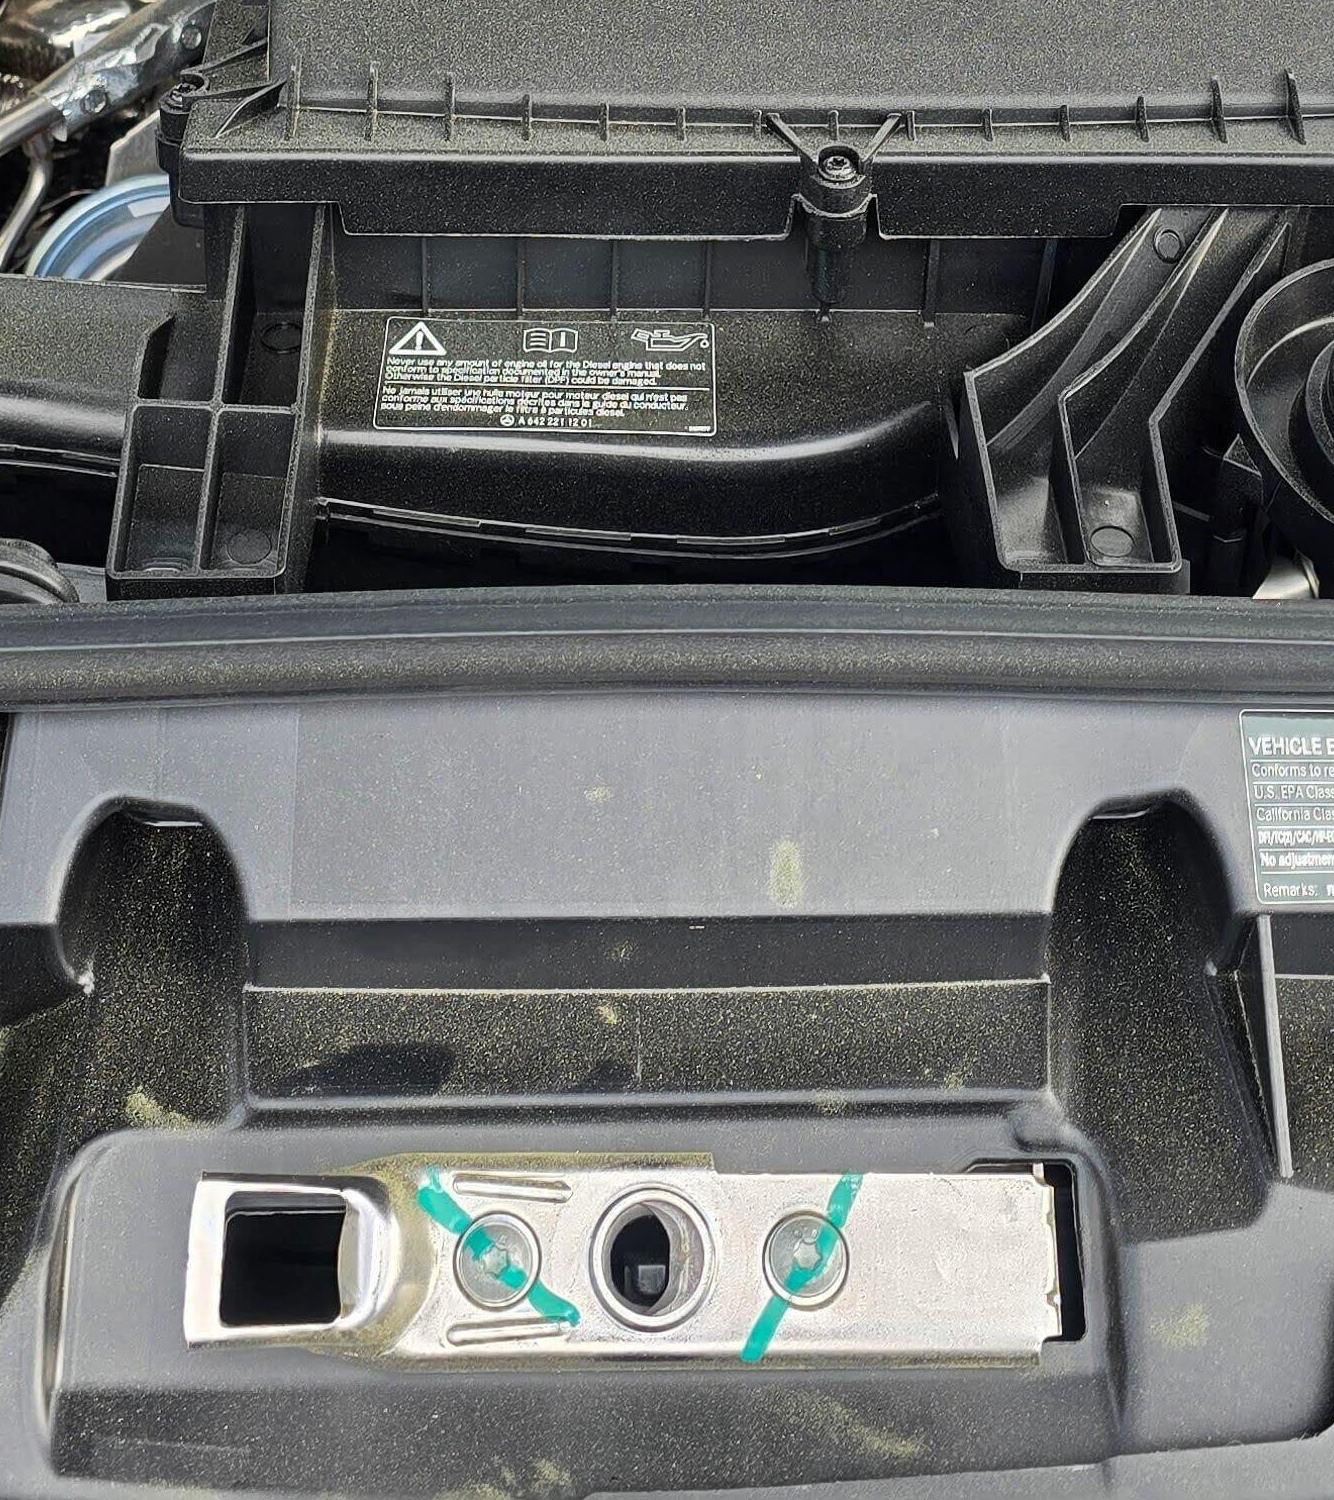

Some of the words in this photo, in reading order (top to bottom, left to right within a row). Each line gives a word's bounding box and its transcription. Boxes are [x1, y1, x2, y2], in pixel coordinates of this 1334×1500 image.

[386, 357, 415, 366] Never
[436, 359, 454, 367] any
[455, 360, 489, 368] amount
[504, 360, 535, 369] engine
[537, 360, 547, 368] oil
[566, 361, 581, 369] the
[582, 361, 611, 369] Diesel
[612, 362, 643, 370] engine
[644, 361, 664, 370] that
[665, 362, 689, 370] does
[690, 363, 706, 371] not
[1249, 736, 1322, 756] VEHICLE
[1251, 764, 1306, 778] Conforms
[1309, 764, 1321, 777] to
[1281, 786, 1304, 799] EPA
[1256, 808, 1310, 822] California
[1260, 852, 1276, 866] No
[1264, 883, 1317, 897] Remarks:
